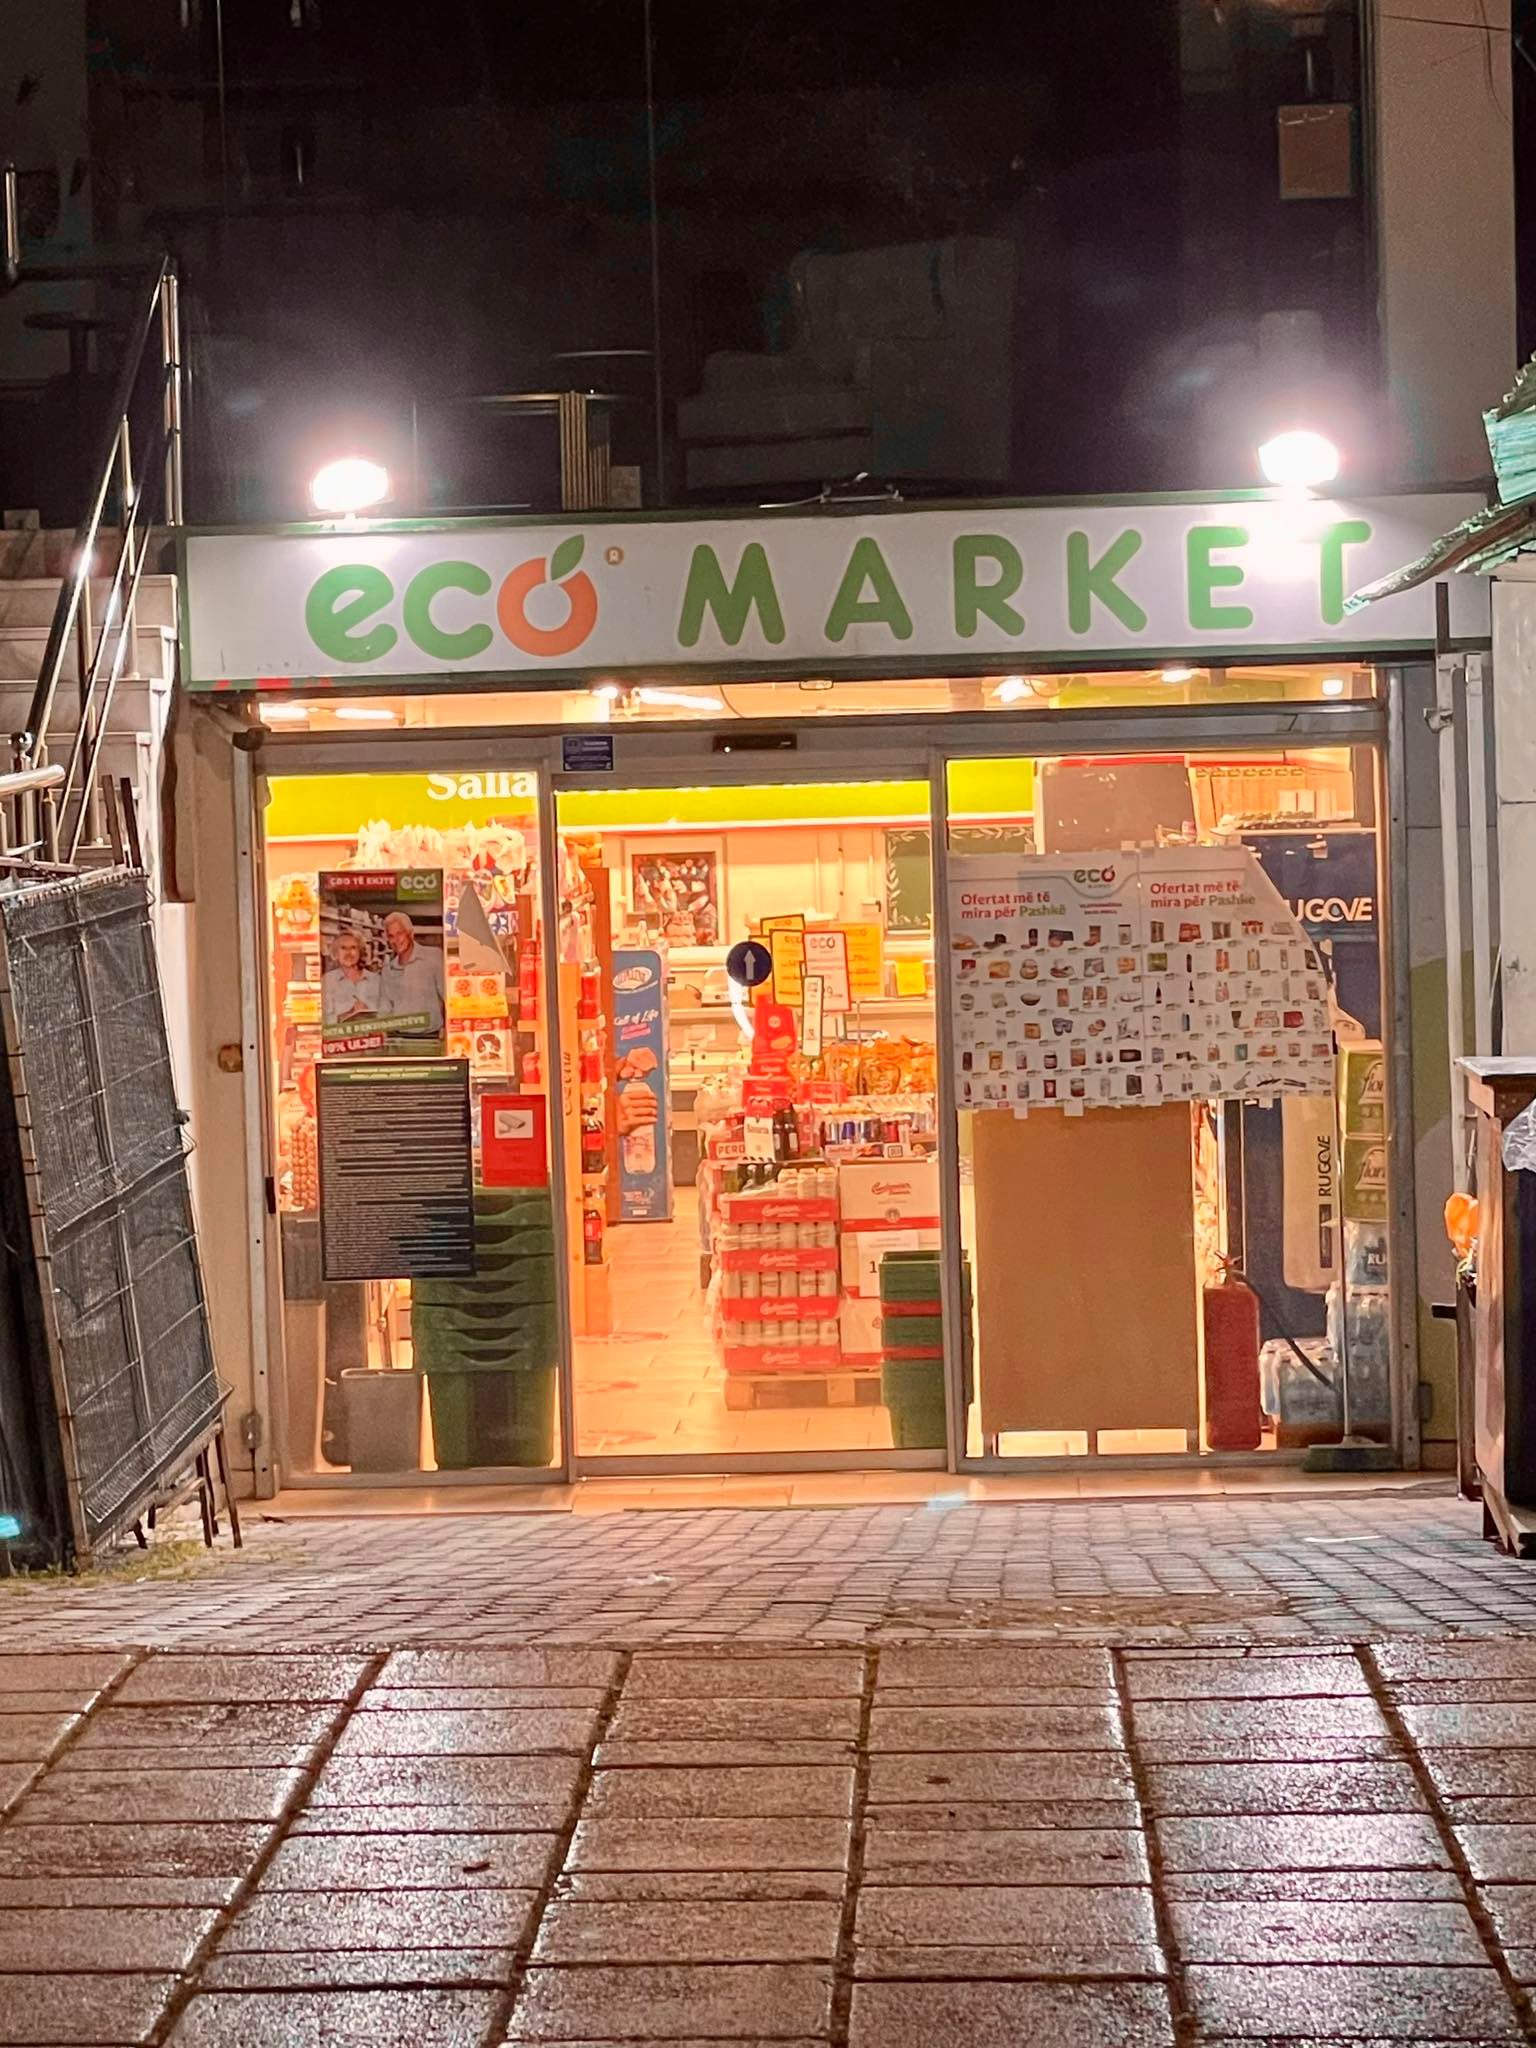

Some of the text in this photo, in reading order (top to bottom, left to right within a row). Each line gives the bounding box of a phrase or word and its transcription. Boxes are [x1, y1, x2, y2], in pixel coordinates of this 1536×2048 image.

[305, 534, 598, 663] eco
[677, 520, 1372, 648] MARKET
[400, 873, 437, 889] eco
[1074, 865, 1116, 883] eco
[1150, 880, 1241, 895] Ofertat më të
[960, 891, 1051, 906] Ofertat më të
[1151, 897, 1182, 908] mira
[1184, 896, 1206, 910] për
[961, 907, 992, 920] mira
[994, 907, 1017, 921] për
[1019, 904, 1067, 918] Pashkë
[1281, 896, 1373, 923] UGOVE
[1316, 1134, 1333, 1198] RUGOVE
